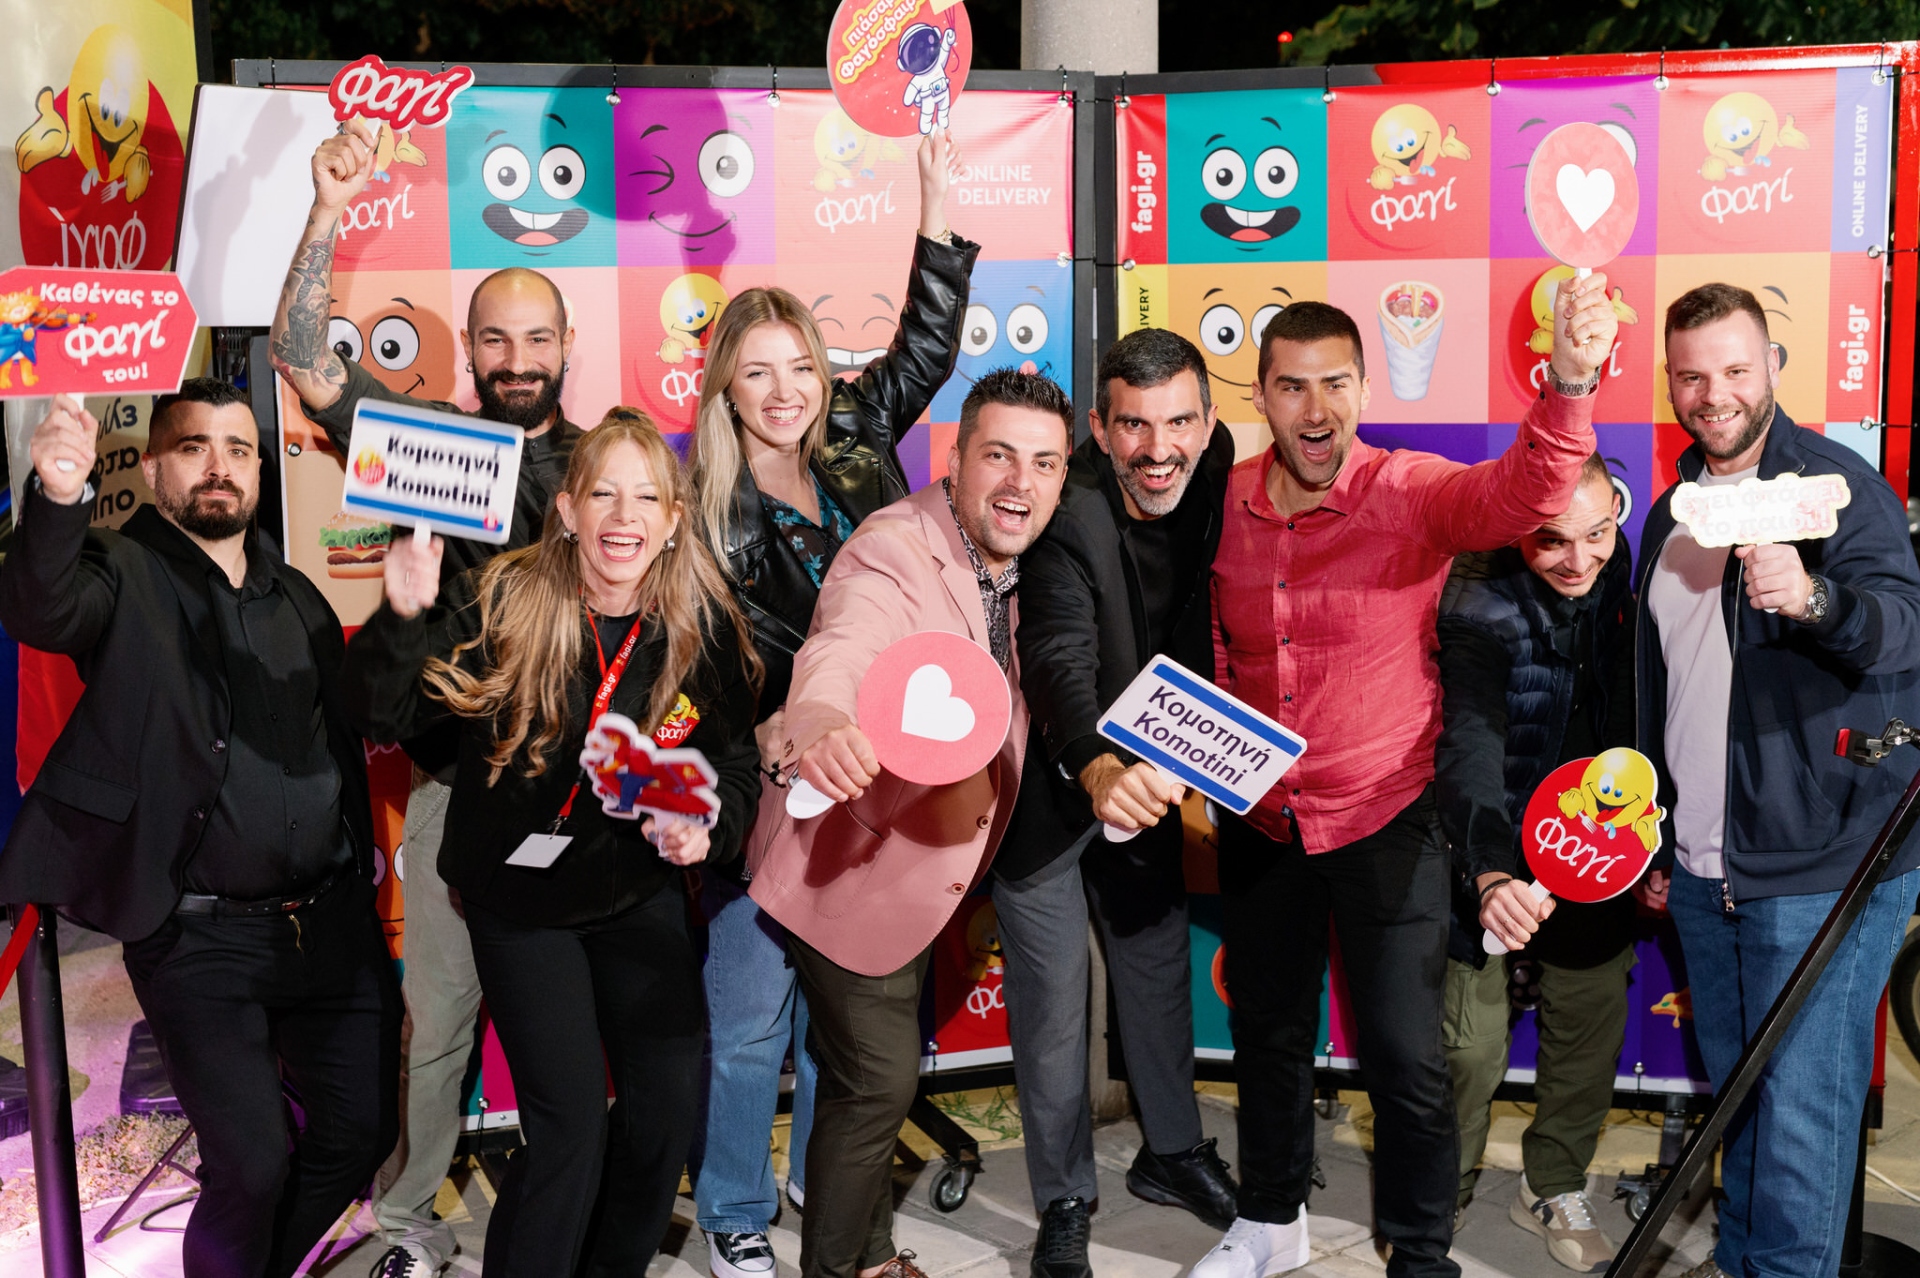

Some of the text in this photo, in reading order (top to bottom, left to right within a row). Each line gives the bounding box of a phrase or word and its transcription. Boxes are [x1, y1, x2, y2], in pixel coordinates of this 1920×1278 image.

[958, 164, 1032, 183] ONLINE
[1851, 104, 1869, 238] ONLINE DELIVERY
[958, 187, 1052, 205] DELIVERY
[1131, 151, 1157, 234] fagi.gr
[40, 281, 179, 309] Καθένας το
[1139, 286, 1149, 326] IVERY
[1838, 304, 1871, 392] fagi.gr
[102, 362, 148, 384] του!
[385, 470, 491, 508] Komotini
[597, 672, 616, 701] fagi.gr
[1132, 710, 1248, 786] Komotini
[1147, 685, 1272, 773] Κομοτηνή
